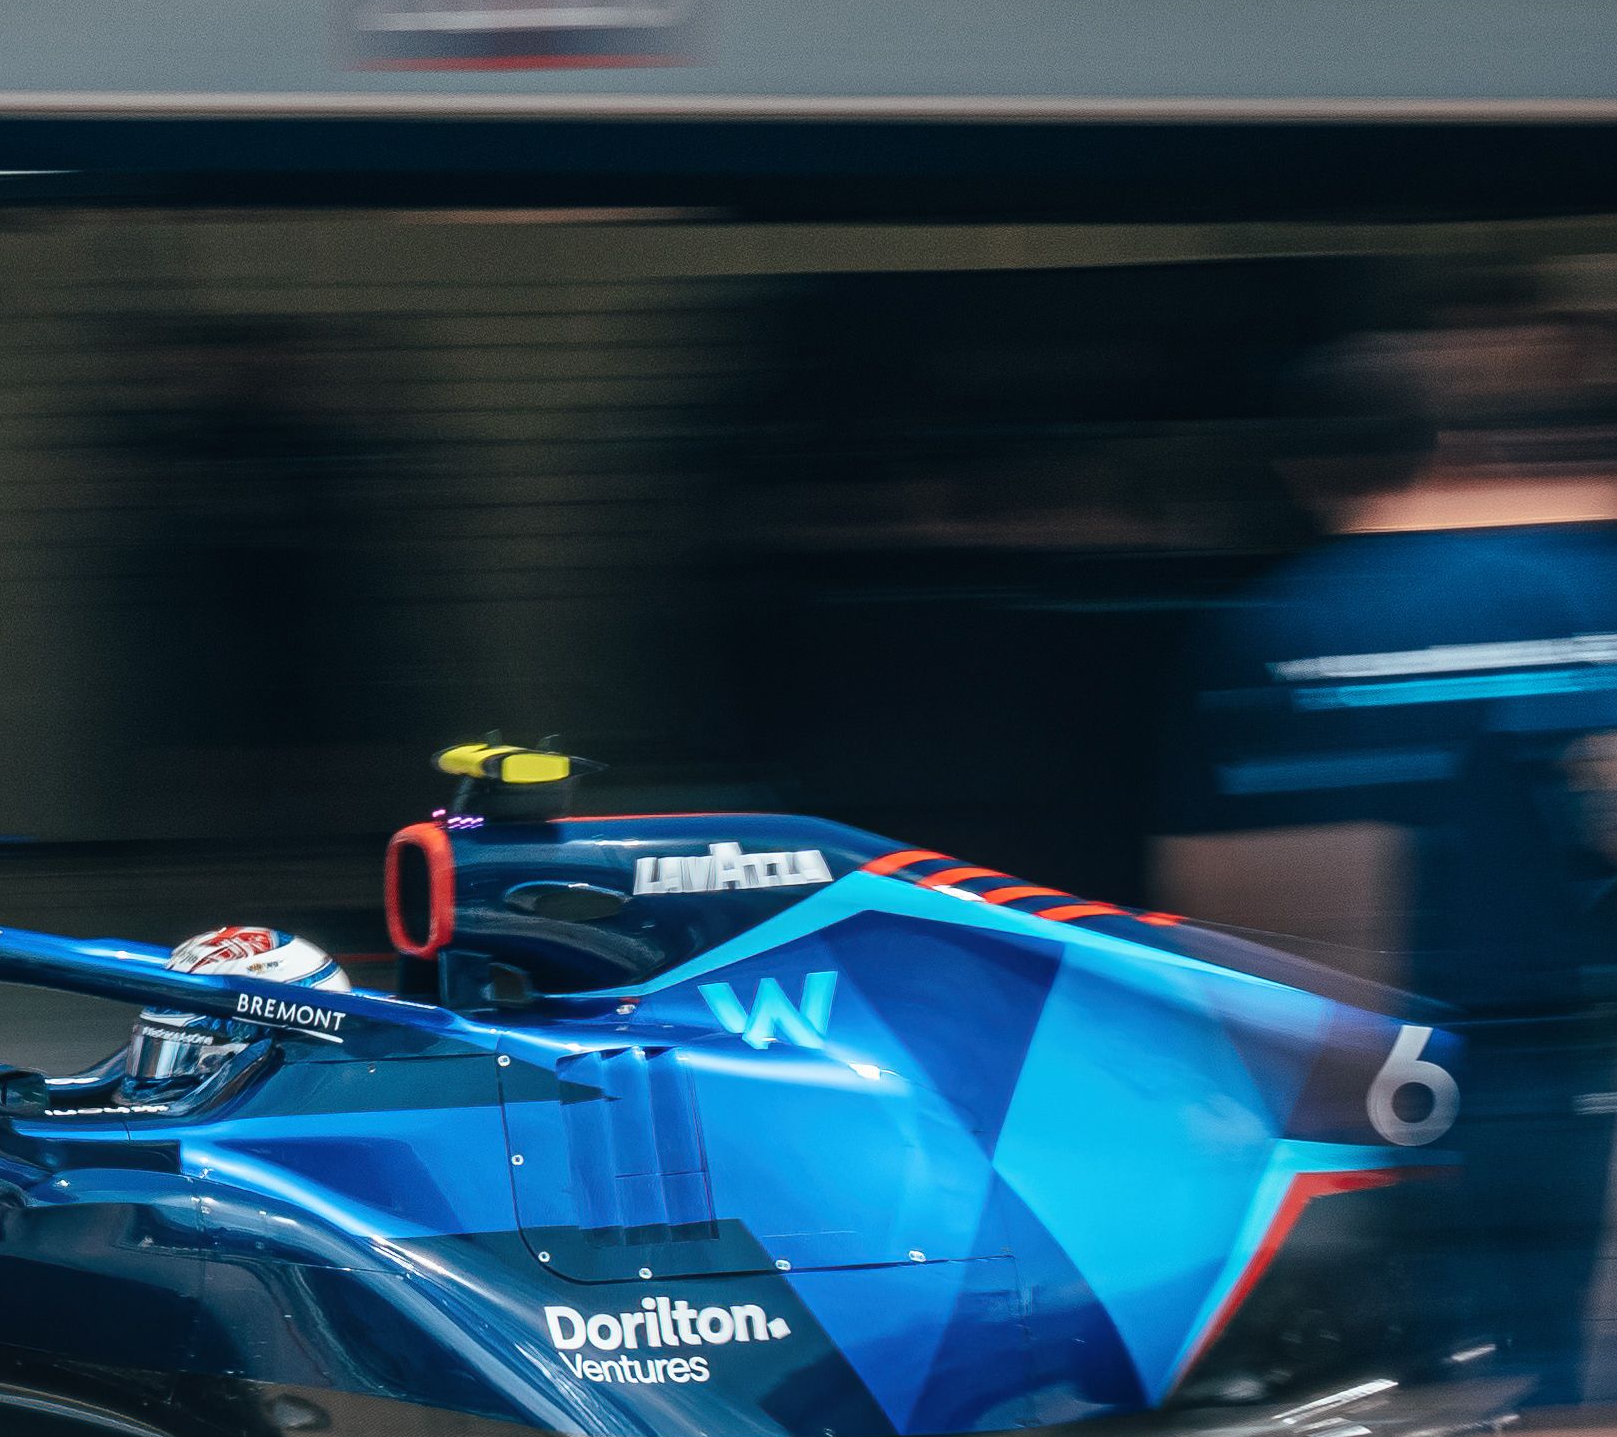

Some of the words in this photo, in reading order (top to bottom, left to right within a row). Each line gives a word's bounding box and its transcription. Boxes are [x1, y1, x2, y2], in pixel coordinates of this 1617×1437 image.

[236, 993, 346, 1031] BREMONT
[1367, 1025, 1461, 1146] 6
[558, 1352, 710, 1384] Ventures
